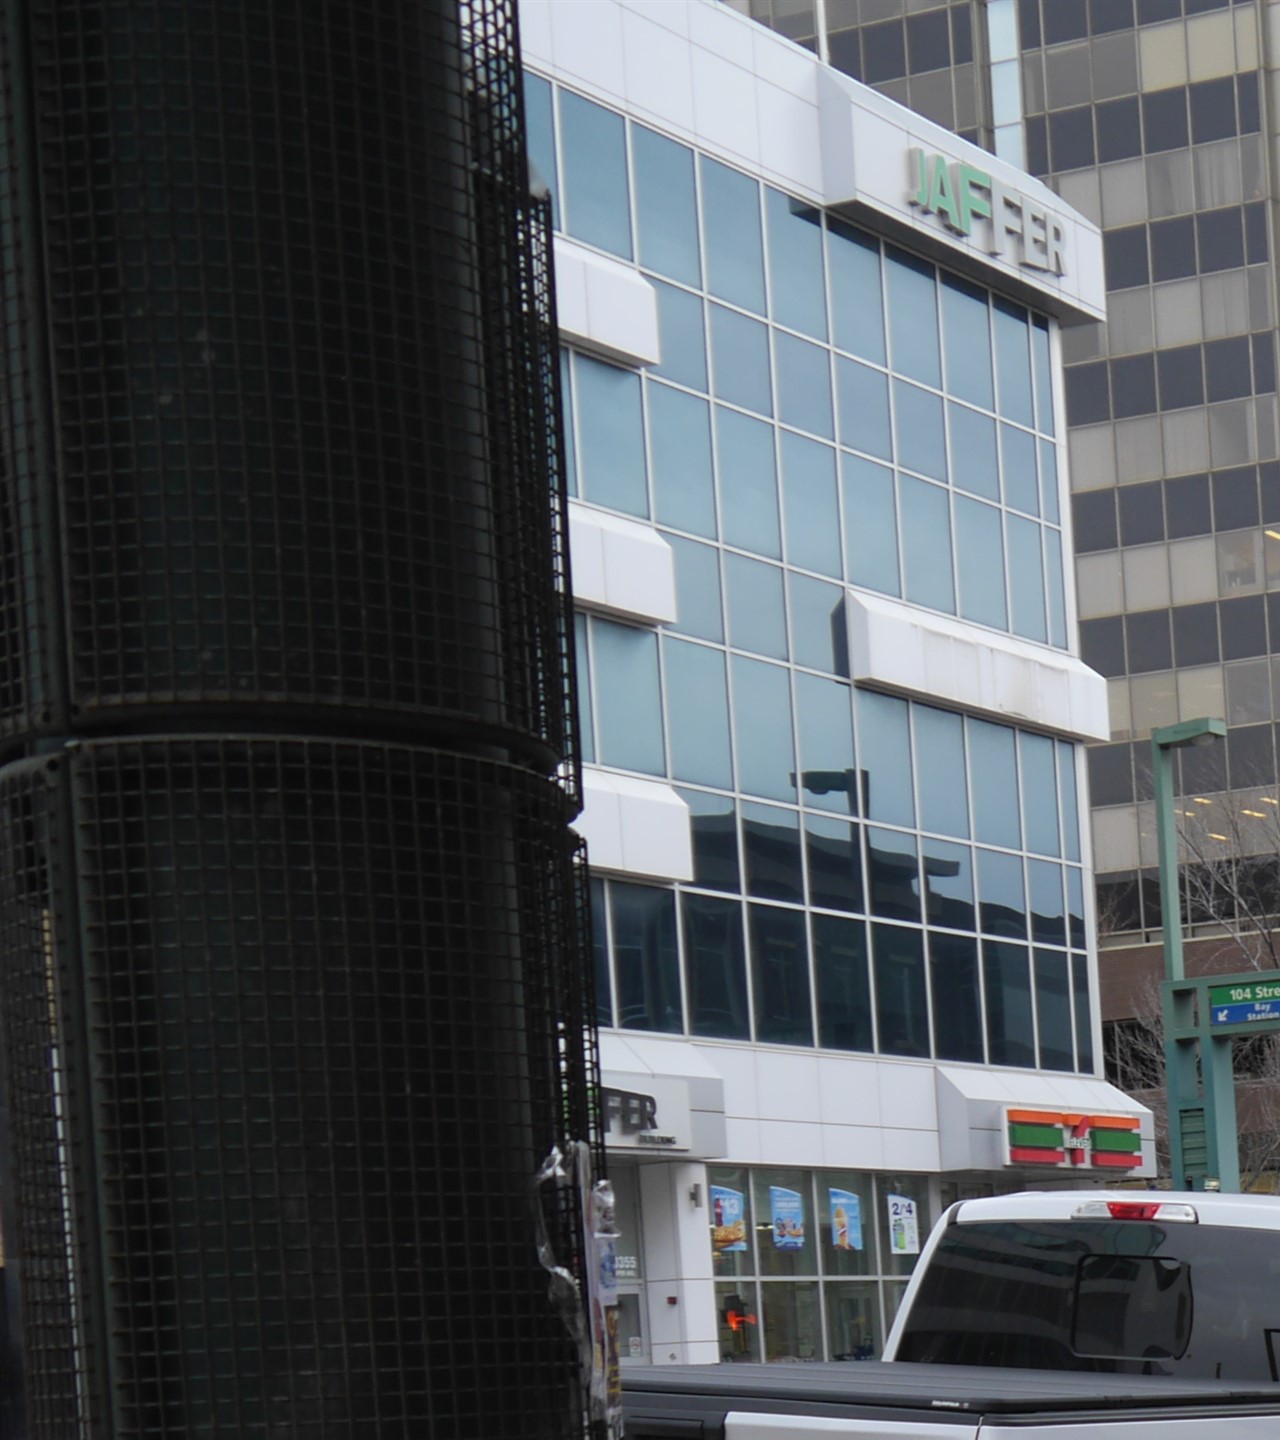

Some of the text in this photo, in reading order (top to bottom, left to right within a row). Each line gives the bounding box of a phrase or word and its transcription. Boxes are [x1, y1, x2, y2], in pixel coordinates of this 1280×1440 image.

[906, 147, 1067, 277] JAFFER
[1229, 988, 1253, 1001] 104
[1254, 1003, 1271, 1013] Bay
[1246, 1011, 1280, 1021] Station
